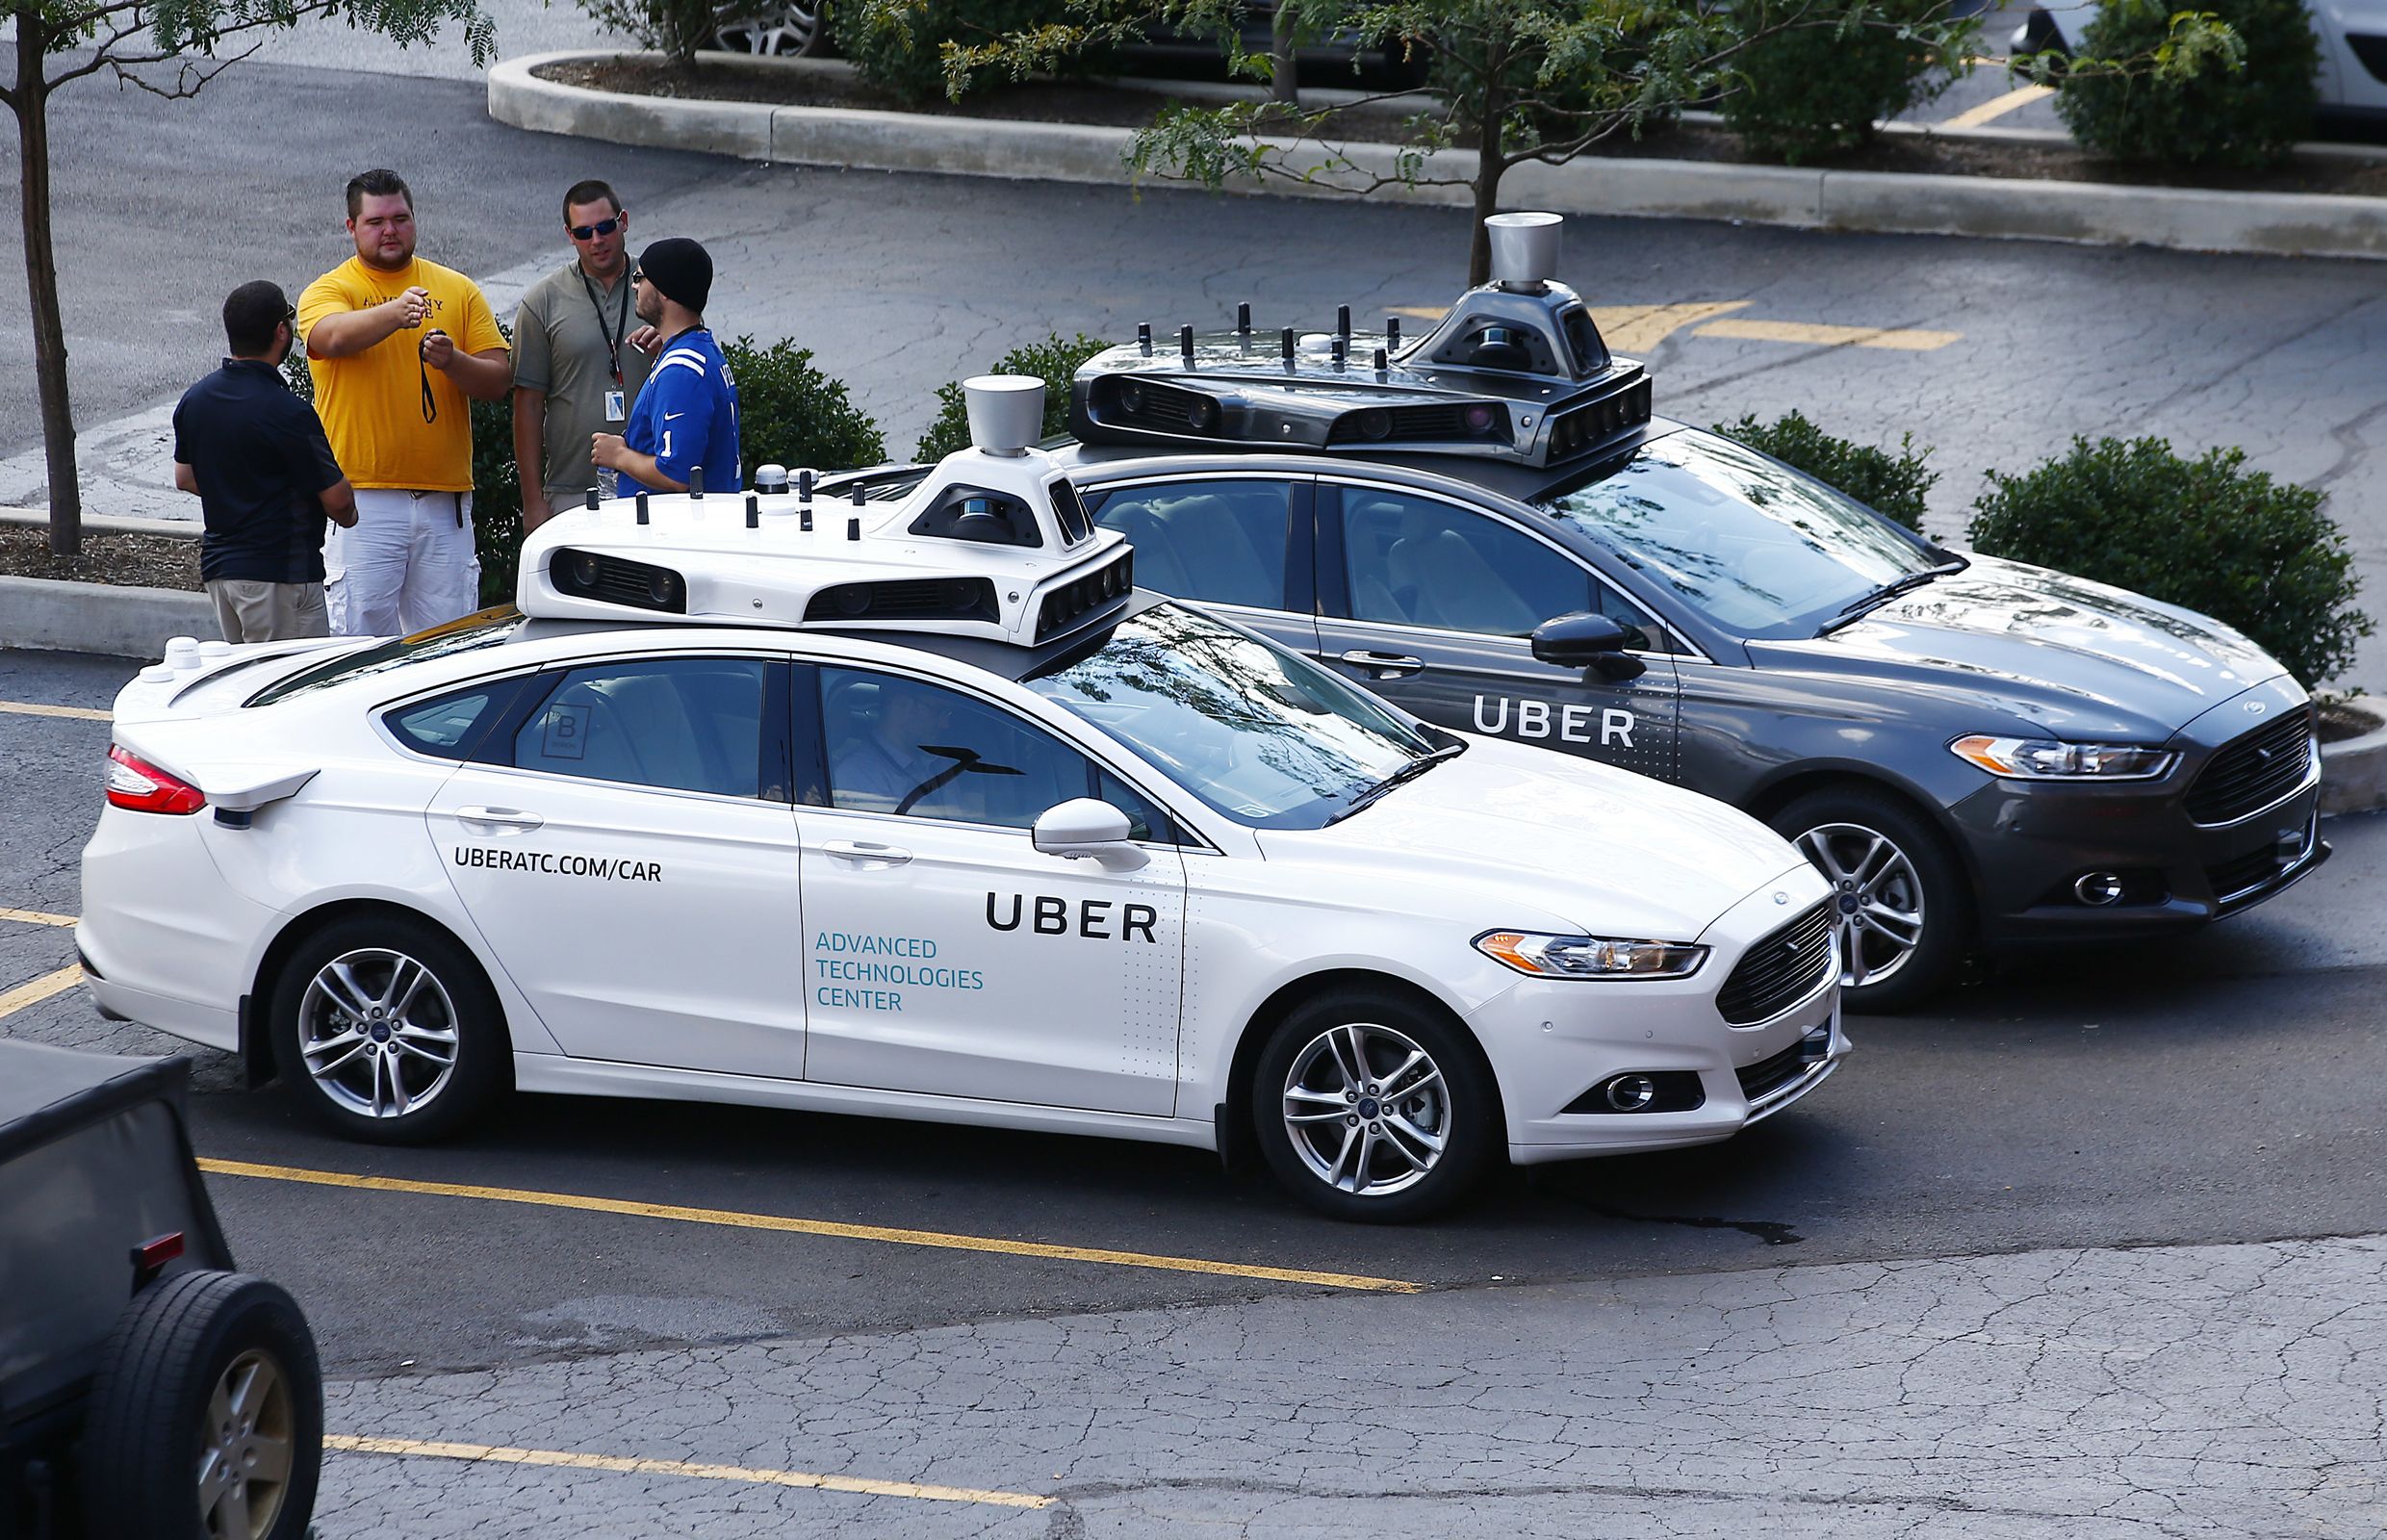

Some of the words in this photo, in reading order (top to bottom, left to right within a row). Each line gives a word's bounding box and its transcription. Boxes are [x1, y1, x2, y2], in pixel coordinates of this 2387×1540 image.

[660, 430, 672, 457] 1
[557, 714, 577, 737] B
[1474, 695, 1635, 748] UBER
[454, 846, 662, 883] UBERATC.COM/CAR
[986, 891, 1158, 944] UBER
[815, 932, 937, 959] ADVANCED
[815, 959, 984, 989] TECHNOLOGIES
[817, 987, 903, 1011] CENTER
